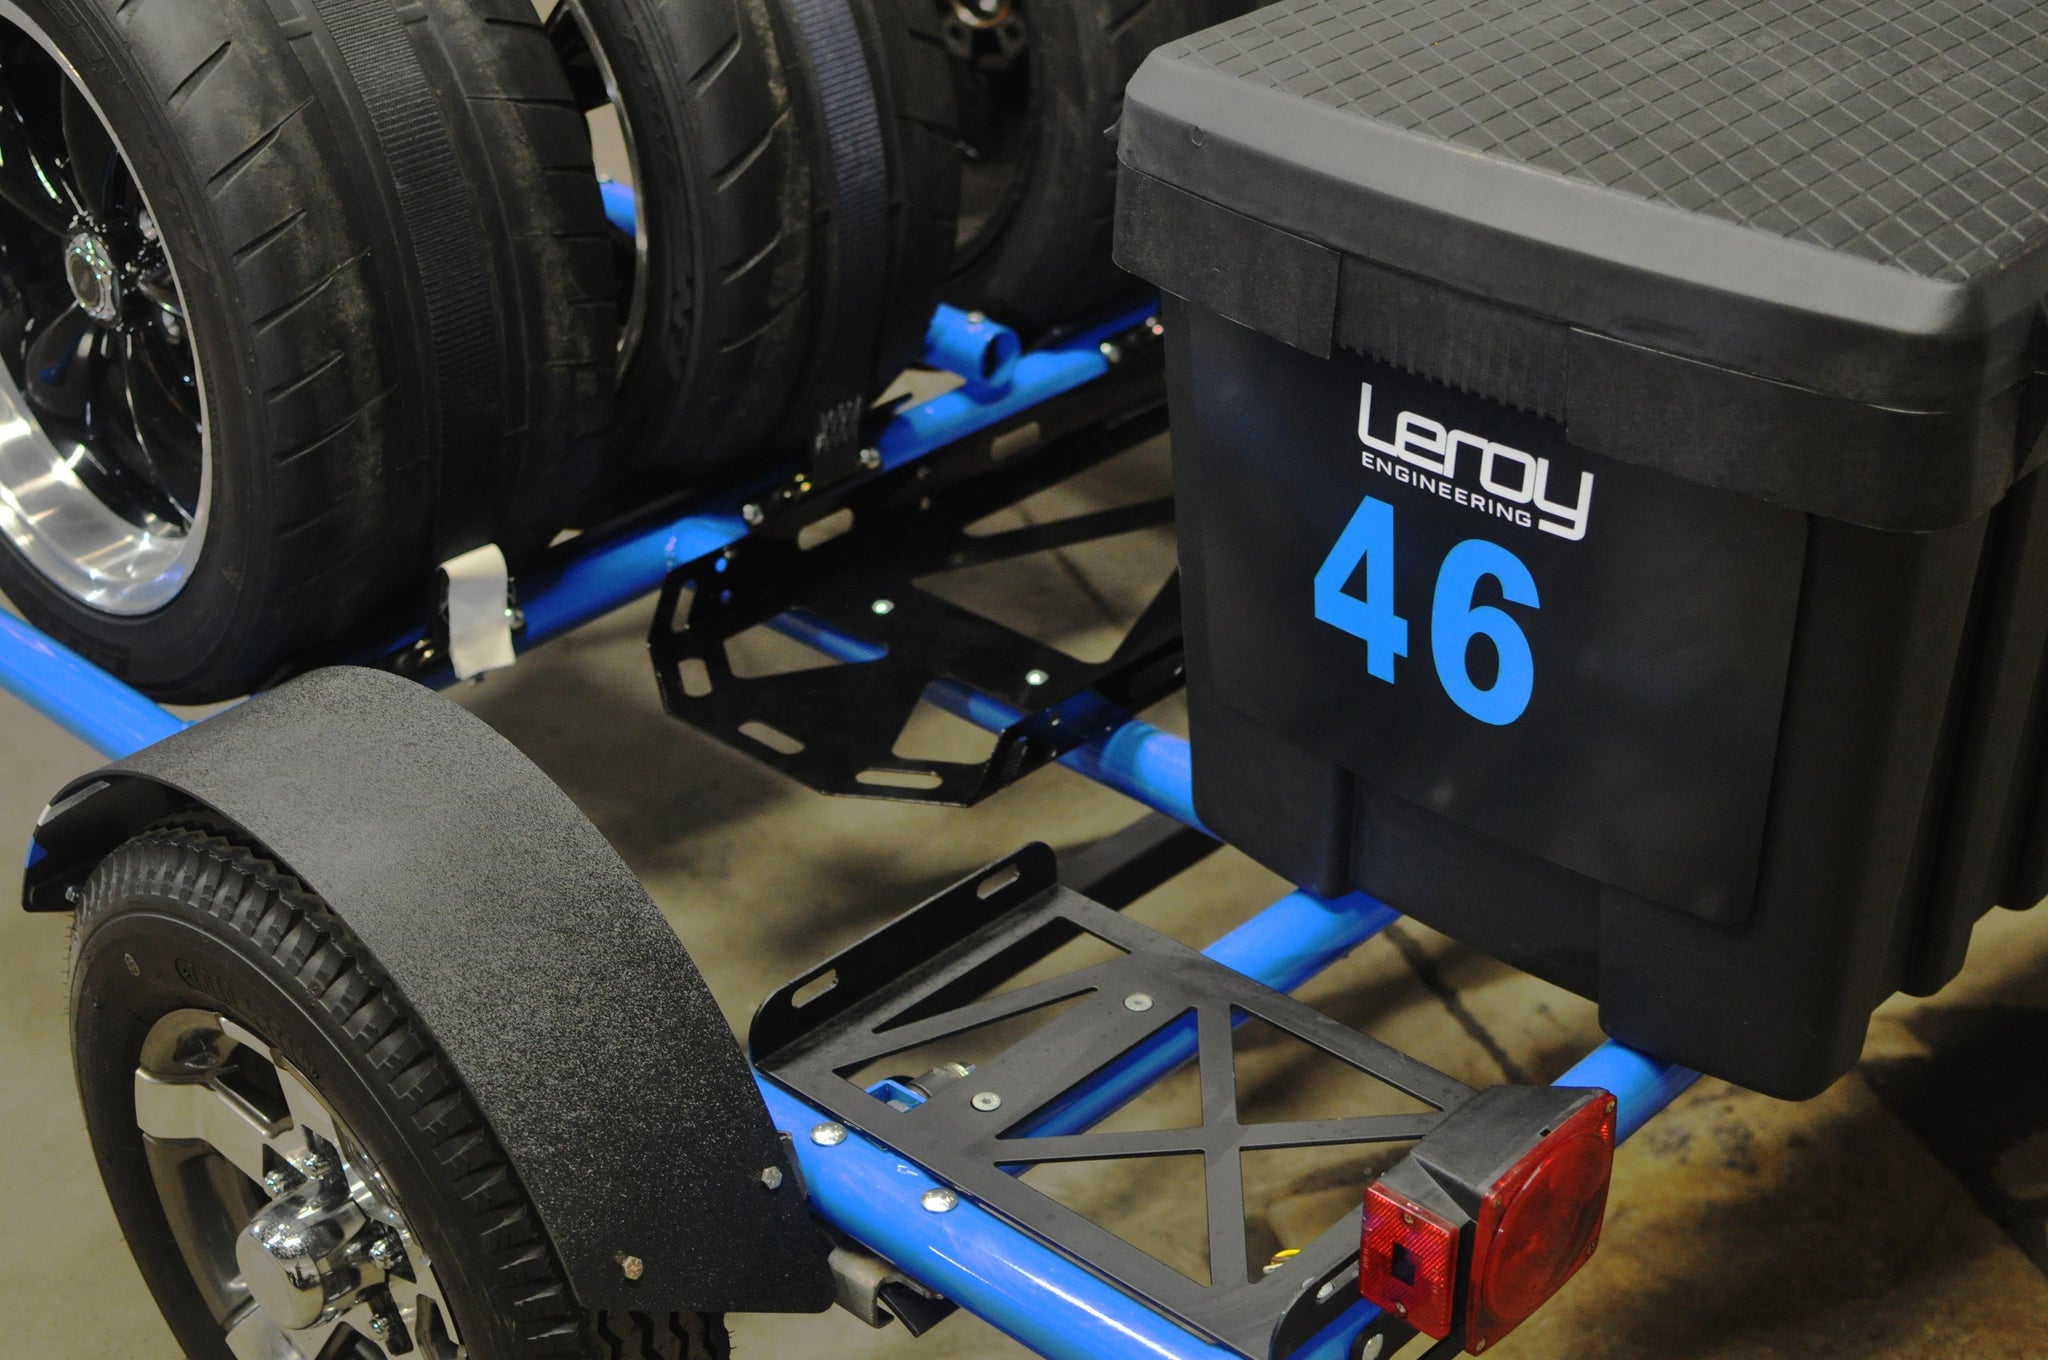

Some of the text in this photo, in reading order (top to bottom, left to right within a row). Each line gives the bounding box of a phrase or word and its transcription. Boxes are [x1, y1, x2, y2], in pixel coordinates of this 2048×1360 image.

[1357, 381, 1595, 541] Leroy
[1361, 451, 1532, 528] ENGINEERING
[1313, 495, 1541, 726] 46
